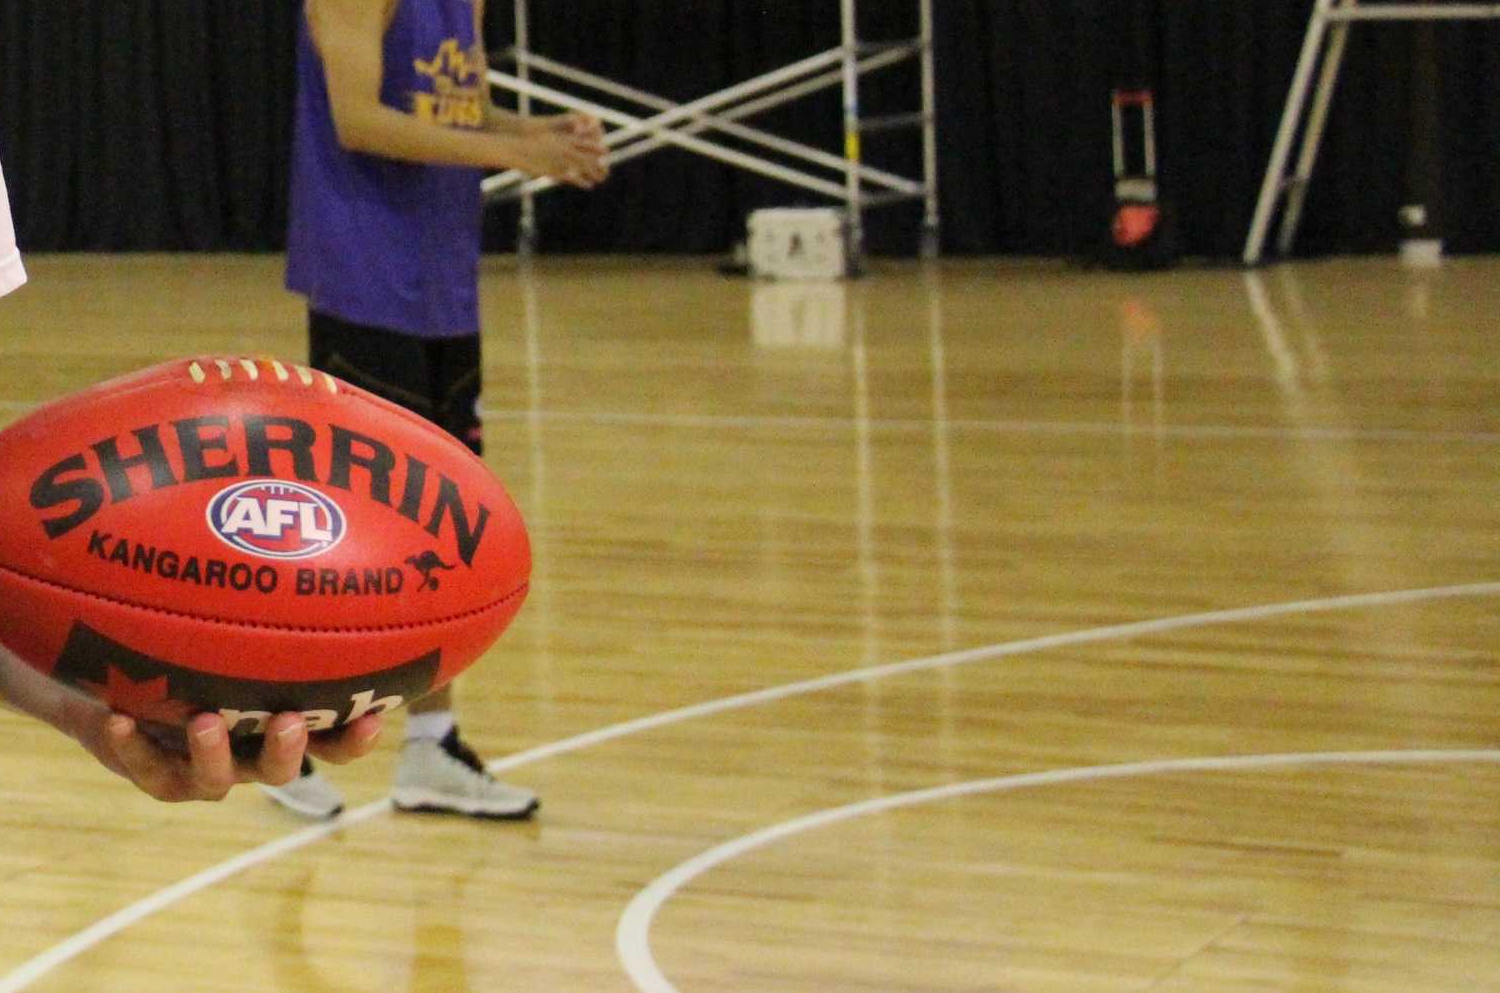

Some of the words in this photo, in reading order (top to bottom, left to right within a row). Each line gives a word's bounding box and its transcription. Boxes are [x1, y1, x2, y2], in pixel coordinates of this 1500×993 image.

[29, 414, 490, 568] SHERRIN
[221, 496, 333, 541] AFL
[87, 529, 278, 594] KANGAROO
[295, 566, 405, 596] BRAND
